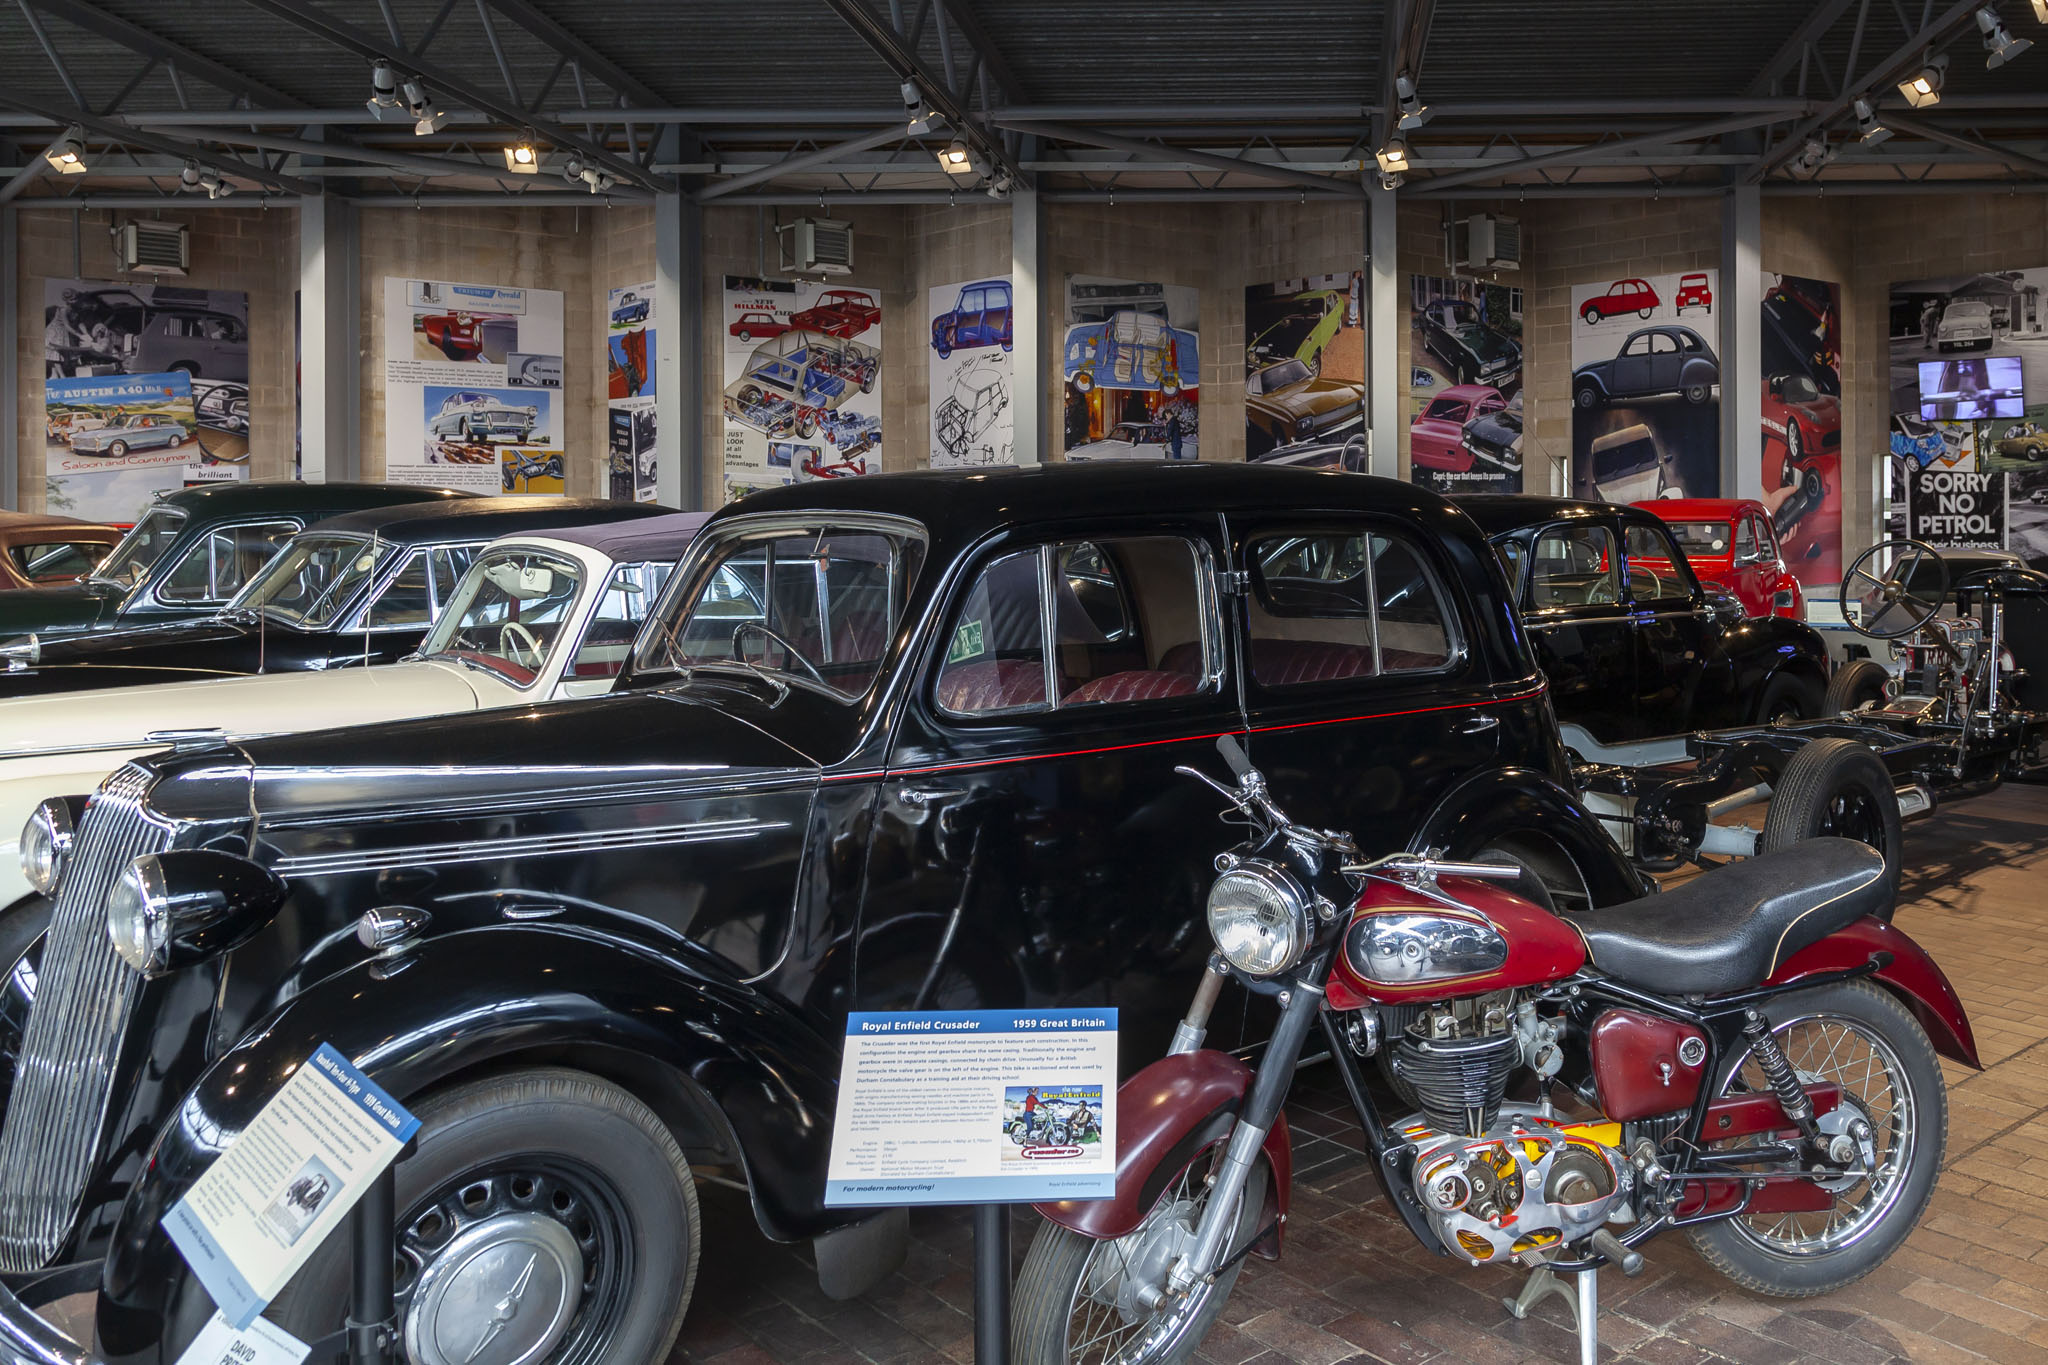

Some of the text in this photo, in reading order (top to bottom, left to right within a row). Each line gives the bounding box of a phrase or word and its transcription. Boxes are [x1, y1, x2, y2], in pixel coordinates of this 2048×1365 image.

[64, 387, 113, 398] AUSTIN
[61, 454, 191, 471] Saloon and Countryman
[1920, 473, 1992, 493] SORRY
[1939, 494, 1975, 514] NO
[1919, 515, 1995, 535] PETROL
[1926, 540, 1948, 549] ther
[862, 1020, 980, 1032] Royal Enfield Crusader
[1013, 1018, 1105, 1028] 1959 Great Britain
[372, 1100, 387, 1117] Great
[383, 1110, 401, 1129] Britain
[886, 1184, 935, 1192] motorcycling!
[230, 1340, 256, 1362] DAVID
